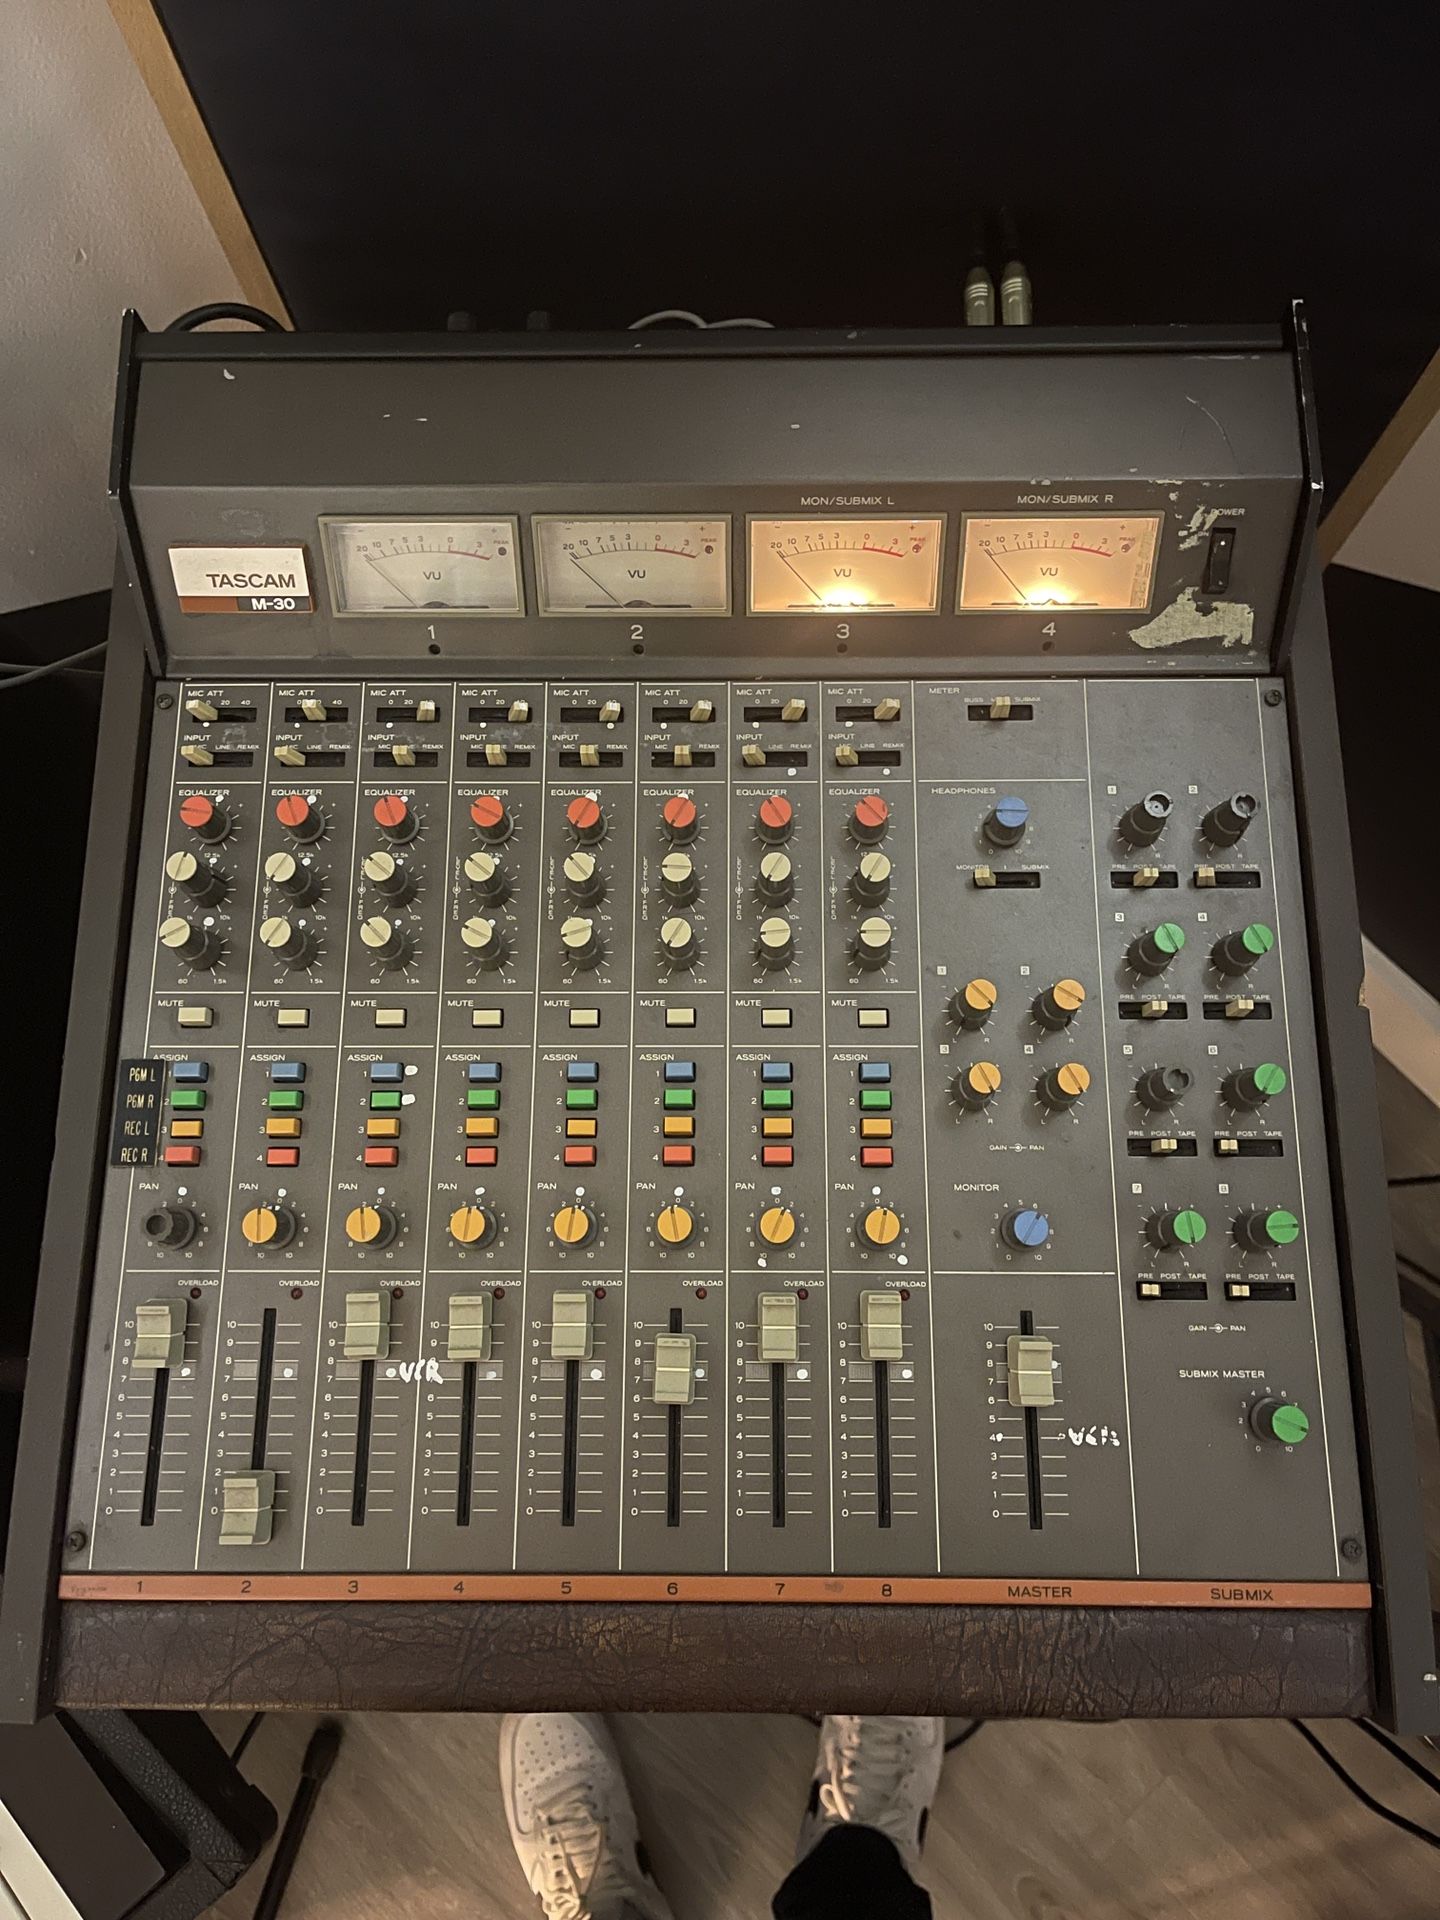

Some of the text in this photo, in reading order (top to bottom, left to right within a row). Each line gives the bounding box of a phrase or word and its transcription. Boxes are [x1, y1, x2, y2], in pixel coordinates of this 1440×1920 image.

[801, 496, 894, 506] MON/SUBMIX L
[1017, 494, 1114, 504] MON/SUBMIX R
[423, 571, 441, 580] VU
[628, 570, 646, 579] VU
[833, 568, 852, 577] VU
[1040, 567, 1058, 576] VU
[206, 574, 296, 588] TASCAM
[251, 598, 296, 610] M-30
[428, 625, 435, 639] 1
[630, 624, 644, 639] 2
[836, 624, 850, 639] 3
[1042, 622, 1056, 636] 4
[150, 1068, 156, 1082] L
[148, 1094, 154, 1108] R
[124, 1121, 150, 1136] REC L
[120, 1148, 148, 1162] REC R
[954, 1184, 999, 1192] MONITOR
[984, 1323, 994, 1331] 10
[987, 1360, 993, 1368] 8
[1179, 1370, 1265, 1378] SUBMIX MASTER
[988, 1378, 994, 1386] 7
[988, 1396, 995, 1404] 6
[989, 1415, 996, 1423] 5
[990, 1452, 997, 1460] 3
[991, 1471, 998, 1479] 2
[992, 1510, 1000, 1518] 0
[136, 1581, 143, 1593] 1
[241, 1581, 251, 1593] 2
[348, 1581, 359, 1594] 3
[453, 1581, 464, 1594] 4
[561, 1582, 572, 1595] 5
[667, 1583, 678, 1596] 6
[775, 1583, 785, 1596] 7
[882, 1584, 892, 1597] 8
[1007, 1586, 1072, 1598] MASTER
[1210, 1588, 1273, 1601] SUBMIX
